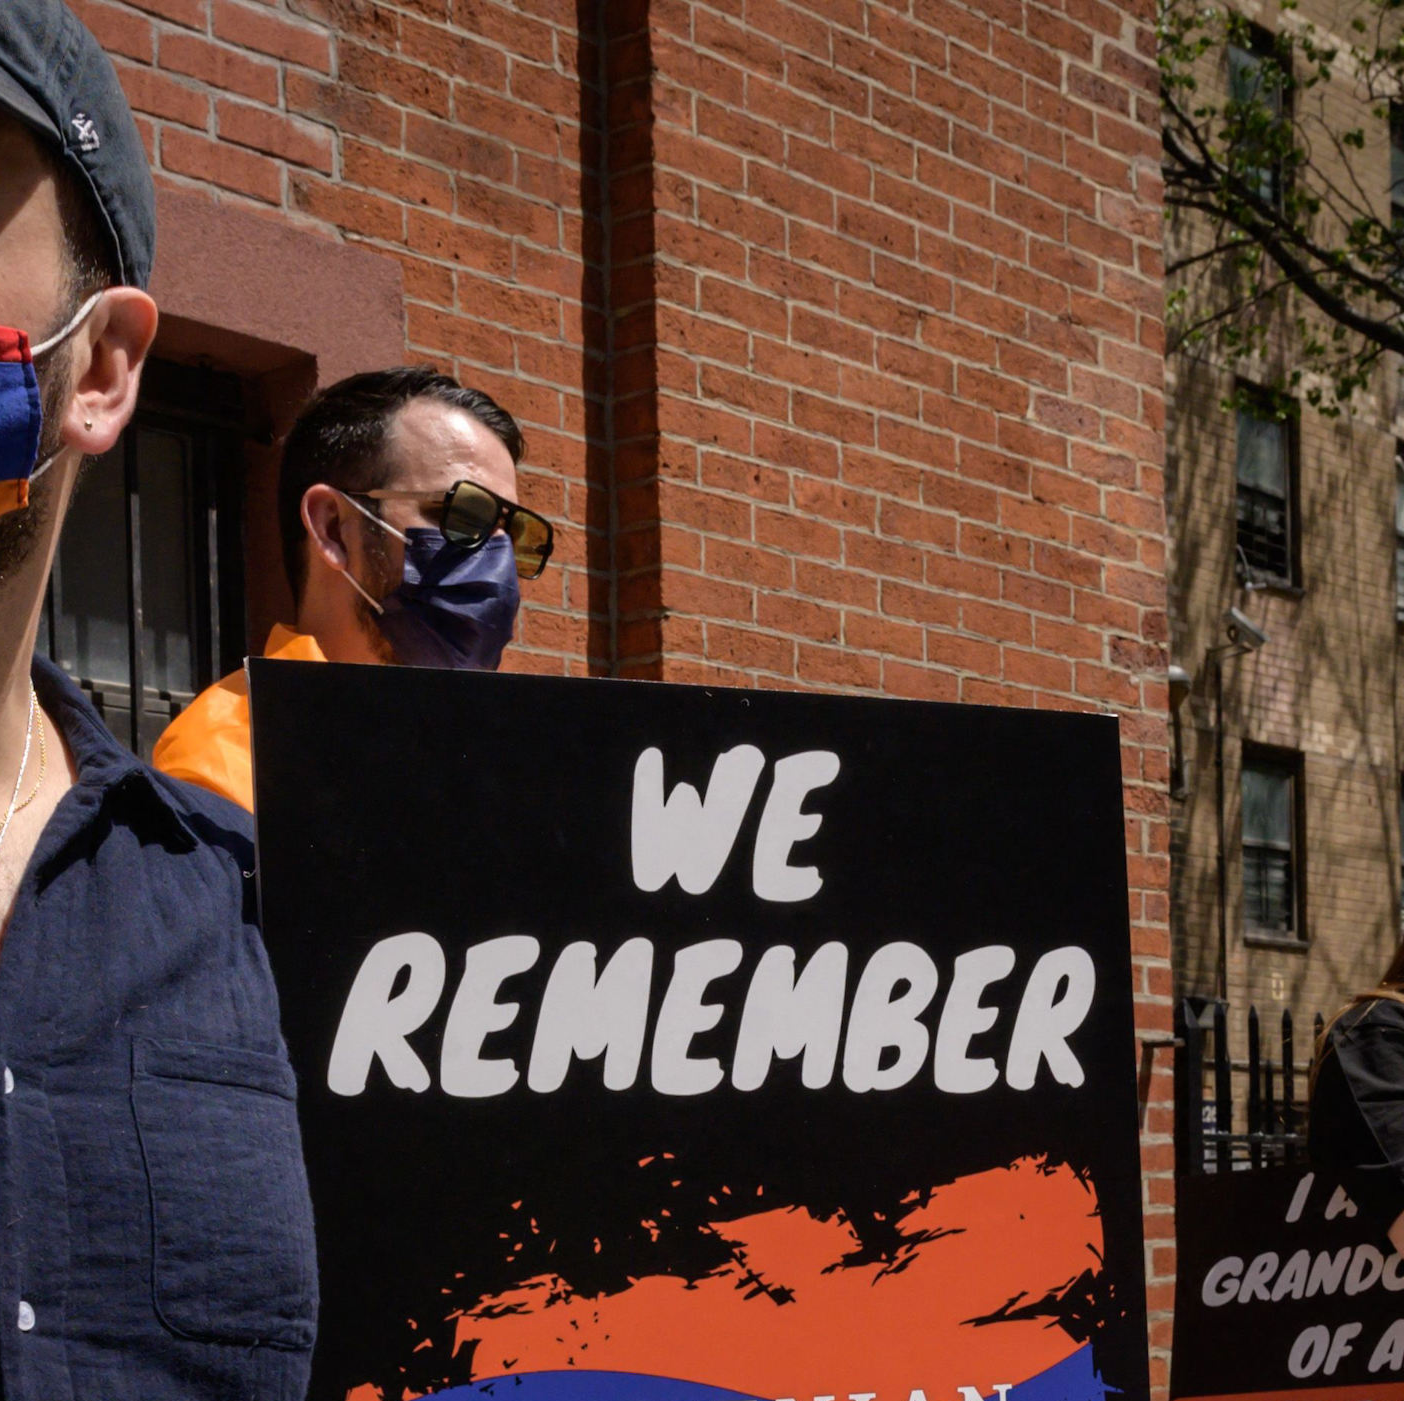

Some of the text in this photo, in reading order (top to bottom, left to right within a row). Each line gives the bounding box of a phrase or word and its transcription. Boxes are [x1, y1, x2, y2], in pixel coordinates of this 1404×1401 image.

[631, 744, 840, 902] WE
[328, 931, 1096, 1097] REMEMBER
[1286, 1172, 1315, 1222] I
[1288, 1322, 1362, 1378] OF
